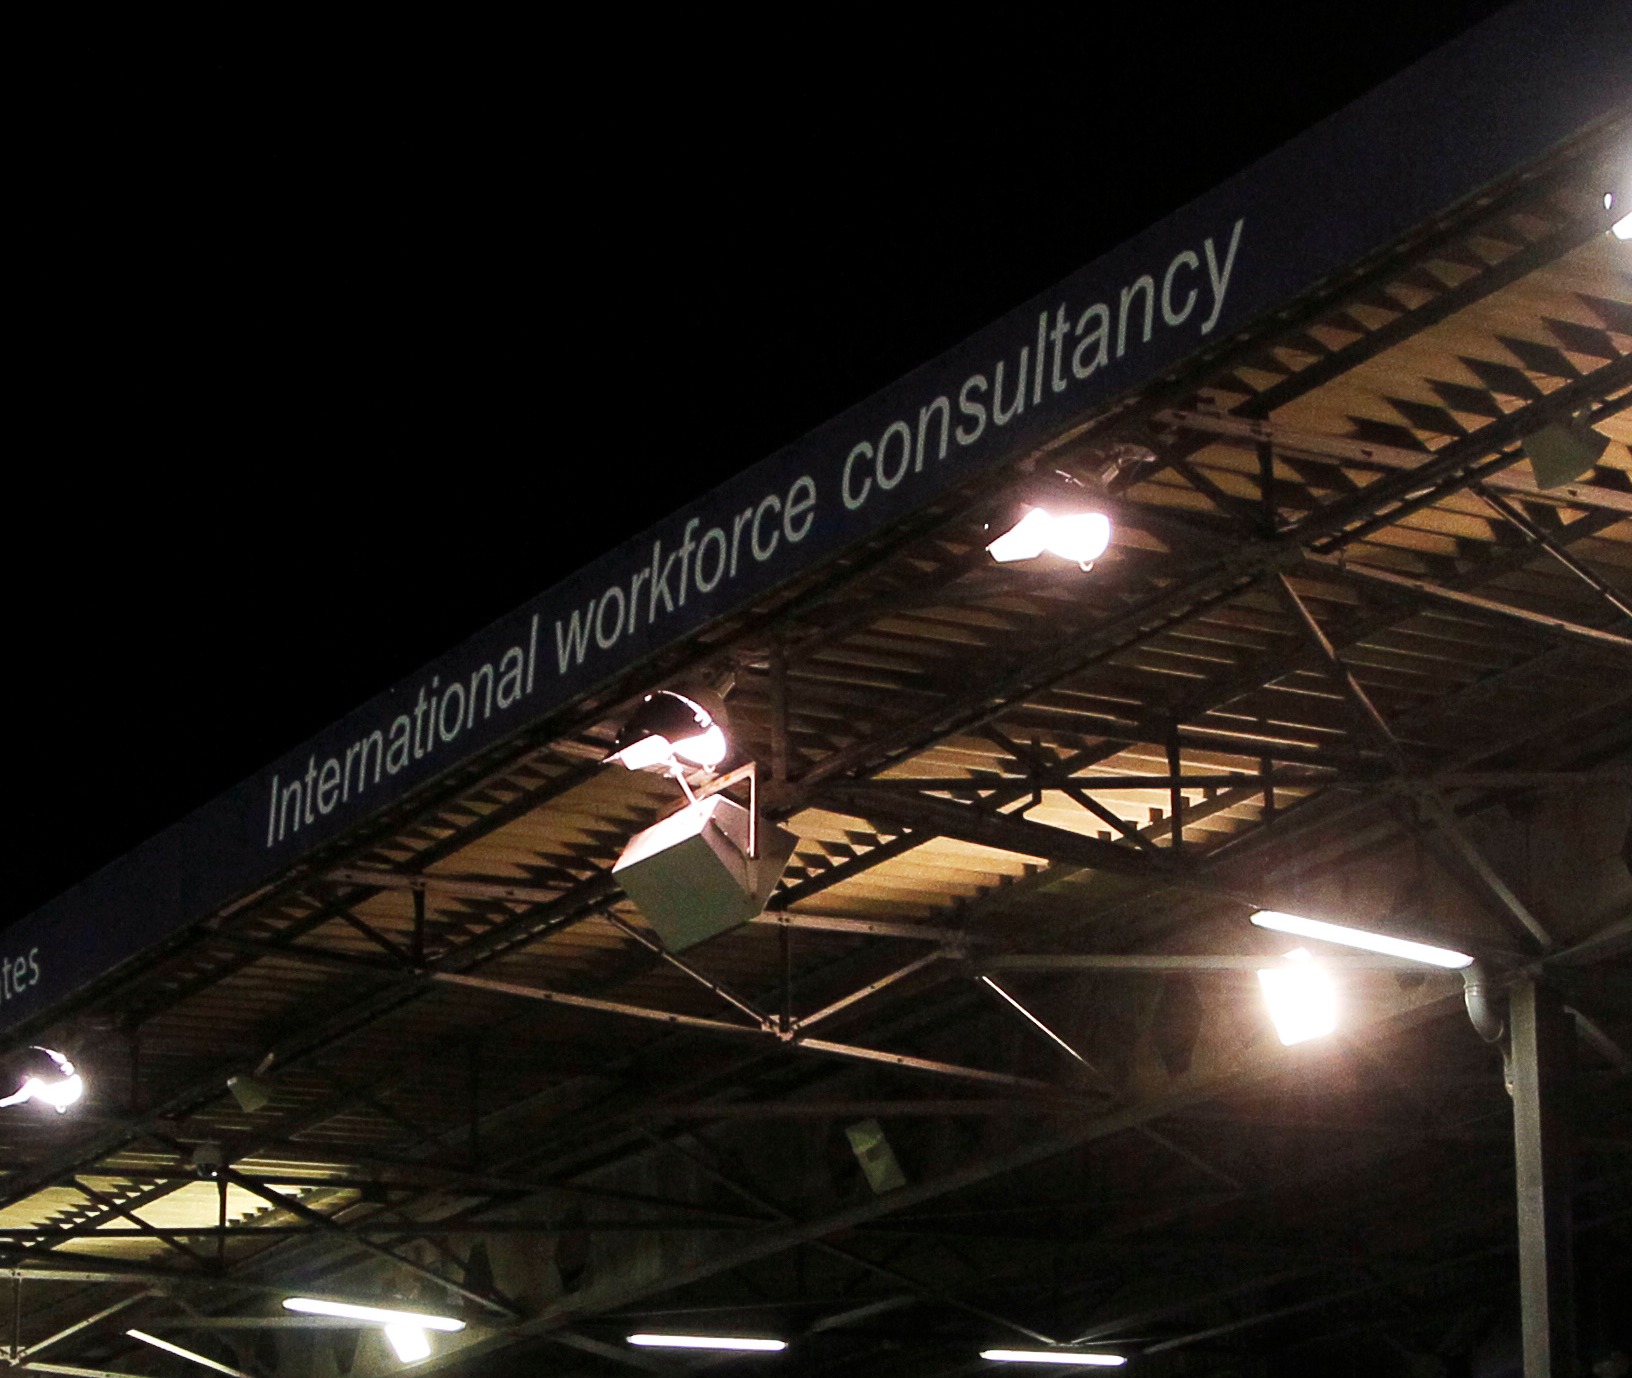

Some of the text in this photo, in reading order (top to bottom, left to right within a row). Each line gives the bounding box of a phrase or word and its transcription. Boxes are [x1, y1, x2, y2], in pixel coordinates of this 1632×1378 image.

[265, 219, 1245, 848] International workforce consultancy
